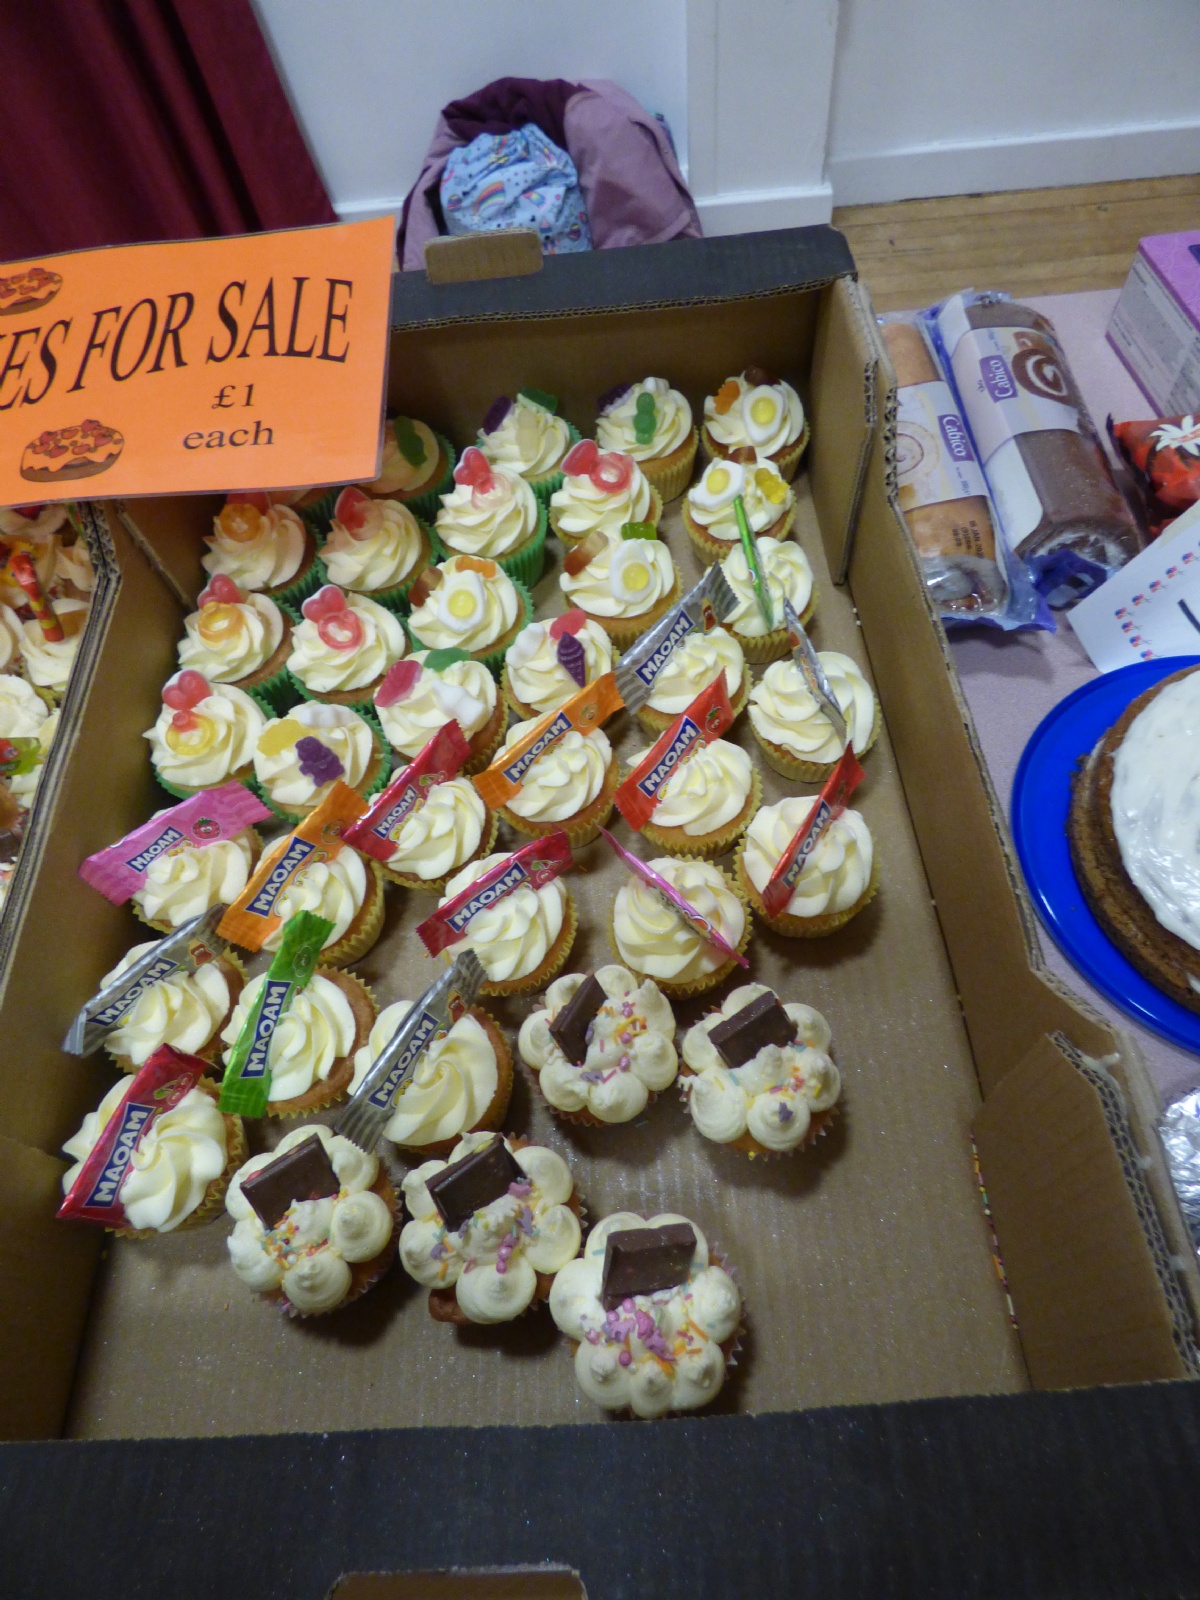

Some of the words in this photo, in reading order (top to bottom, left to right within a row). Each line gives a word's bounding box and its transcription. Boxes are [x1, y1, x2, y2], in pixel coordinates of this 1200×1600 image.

[0, 316, 74, 411] ES
[66, 291, 195, 394] FOR
[205, 276, 353, 365] SALE
[210, 383, 256, 410] £1
[988, 360, 1014, 398] Cabico
[182, 420, 275, 450] each
[943, 416, 967, 456] Cabico
[641, 616, 690, 680] MAOAM
[509, 718, 569, 779] MAOAM
[644, 724, 697, 792] MAOAM
[377, 788, 415, 834] MAOAM
[130, 829, 180, 870] MAOAM
[787, 807, 829, 882] MAOAM
[253, 843, 311, 911] MAOAM
[453, 868, 522, 926] MAOAM
[95, 962, 172, 1023] MAOAM
[247, 986, 287, 1071] MAOAM
[374, 1019, 435, 1102] MAOAM
[93, 1110, 149, 1201] MAOAM
